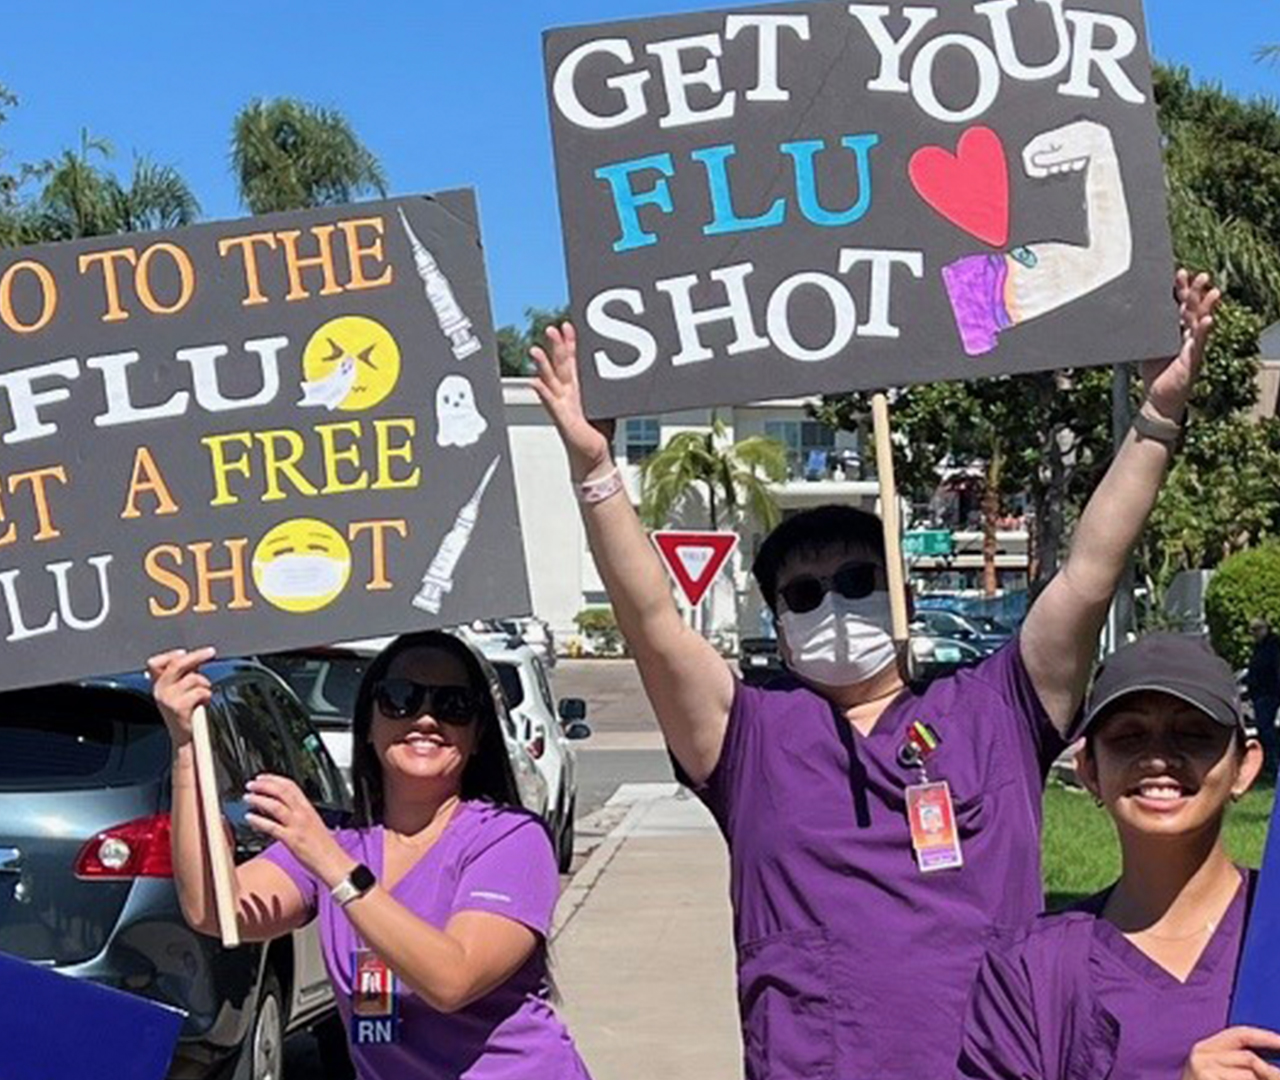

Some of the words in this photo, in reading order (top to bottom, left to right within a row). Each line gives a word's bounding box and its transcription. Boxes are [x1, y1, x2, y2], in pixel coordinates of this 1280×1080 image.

[553, 14, 810, 129] GET
[849, 0, 1146, 122] YOUR
[594, 133, 880, 252] FLU
[79, 241, 195, 323] TO
[219, 216, 395, 307] THE
[585, 248, 924, 380] SHOT
[121, 447, 179, 519] A
[201, 417, 421, 507] FREE
[358, 1020, 391, 1042] RN
